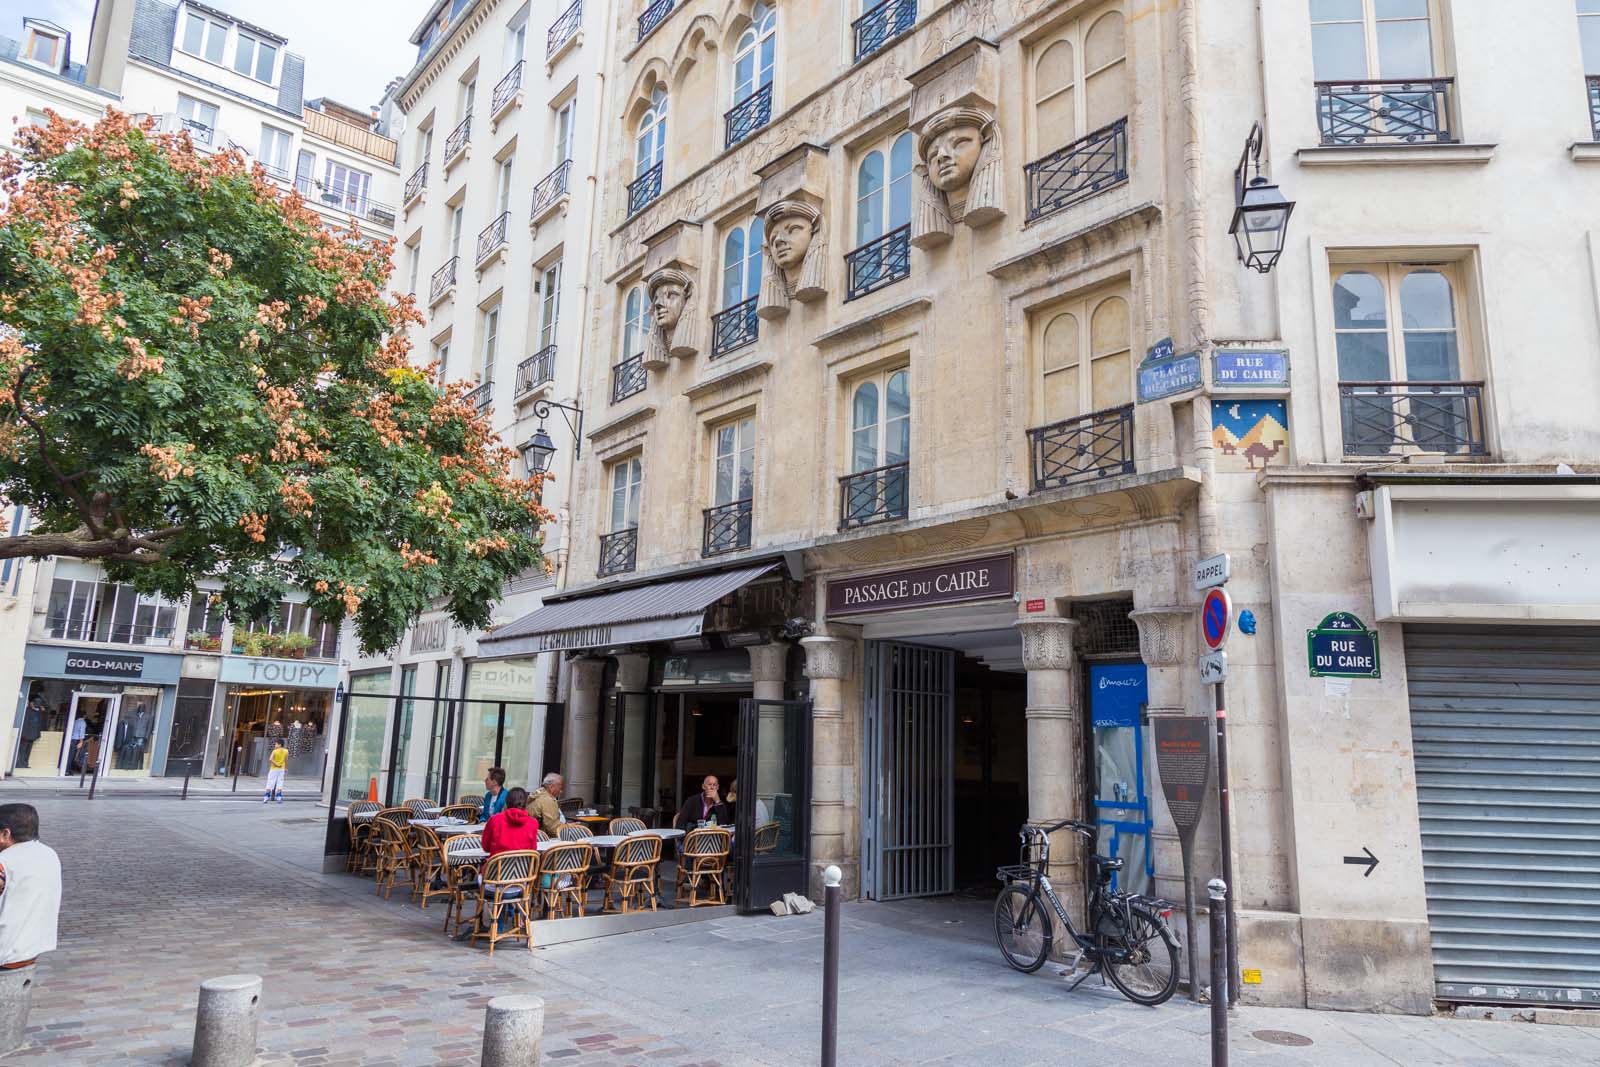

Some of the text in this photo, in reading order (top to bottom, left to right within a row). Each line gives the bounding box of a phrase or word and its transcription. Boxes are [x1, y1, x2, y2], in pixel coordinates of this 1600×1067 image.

[1236, 357, 1264, 367] RUE
[1152, 363, 1187, 380] PLACE
[1222, 370, 1281, 379] DU CAIRE
[1162, 373, 1197, 389] CAIRE
[1196, 563, 1223, 581] RAPPEL
[844, 568, 990, 605] PASSAGE DU CAIRE
[539, 626, 612, 651] LE CHAMPOLLION
[1331, 640, 1356, 652] RUE
[67, 658, 143, 672] GOLD-MAN'S
[1316, 655, 1372, 668] DU CAIRE
[248, 662, 326, 683] TOUPY
